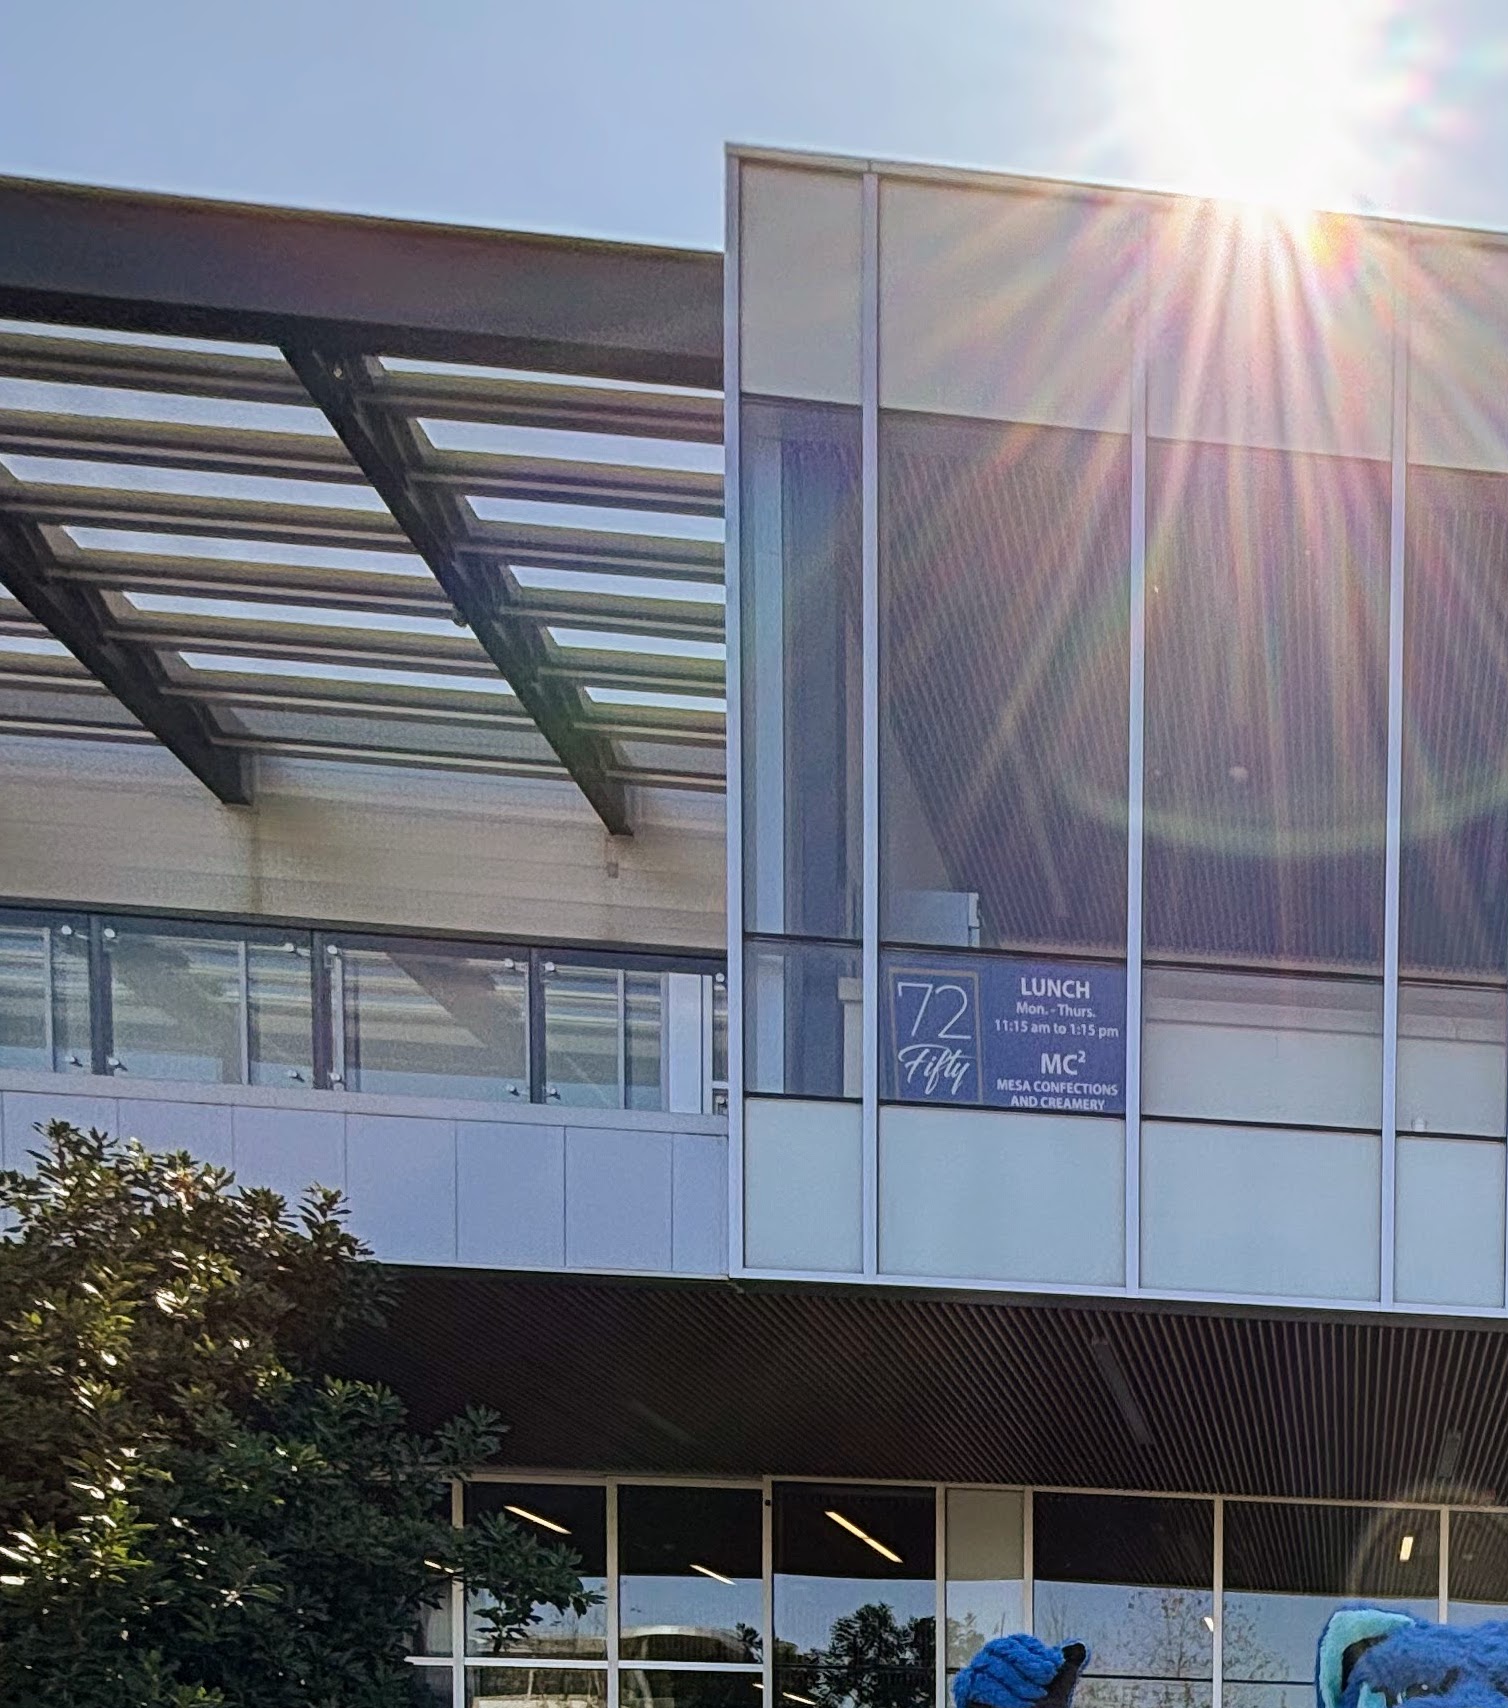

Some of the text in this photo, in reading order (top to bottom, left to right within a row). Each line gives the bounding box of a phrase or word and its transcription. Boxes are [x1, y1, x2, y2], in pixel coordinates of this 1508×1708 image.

[1020, 977, 1090, 999] LUNCH
[897, 981, 972, 1040] 72
[1016, 1002, 1049, 1015] Mon.
[1058, 1003, 1096, 1018] Thurs.
[995, 1020, 1119, 1039] 11:15 am to 1:15 pm
[897, 1043, 977, 1095] Fifty
[996, 1079, 1118, 1096] MESA CONFECTIONS
[1011, 1095, 1105, 1111] AND CREAMERY
